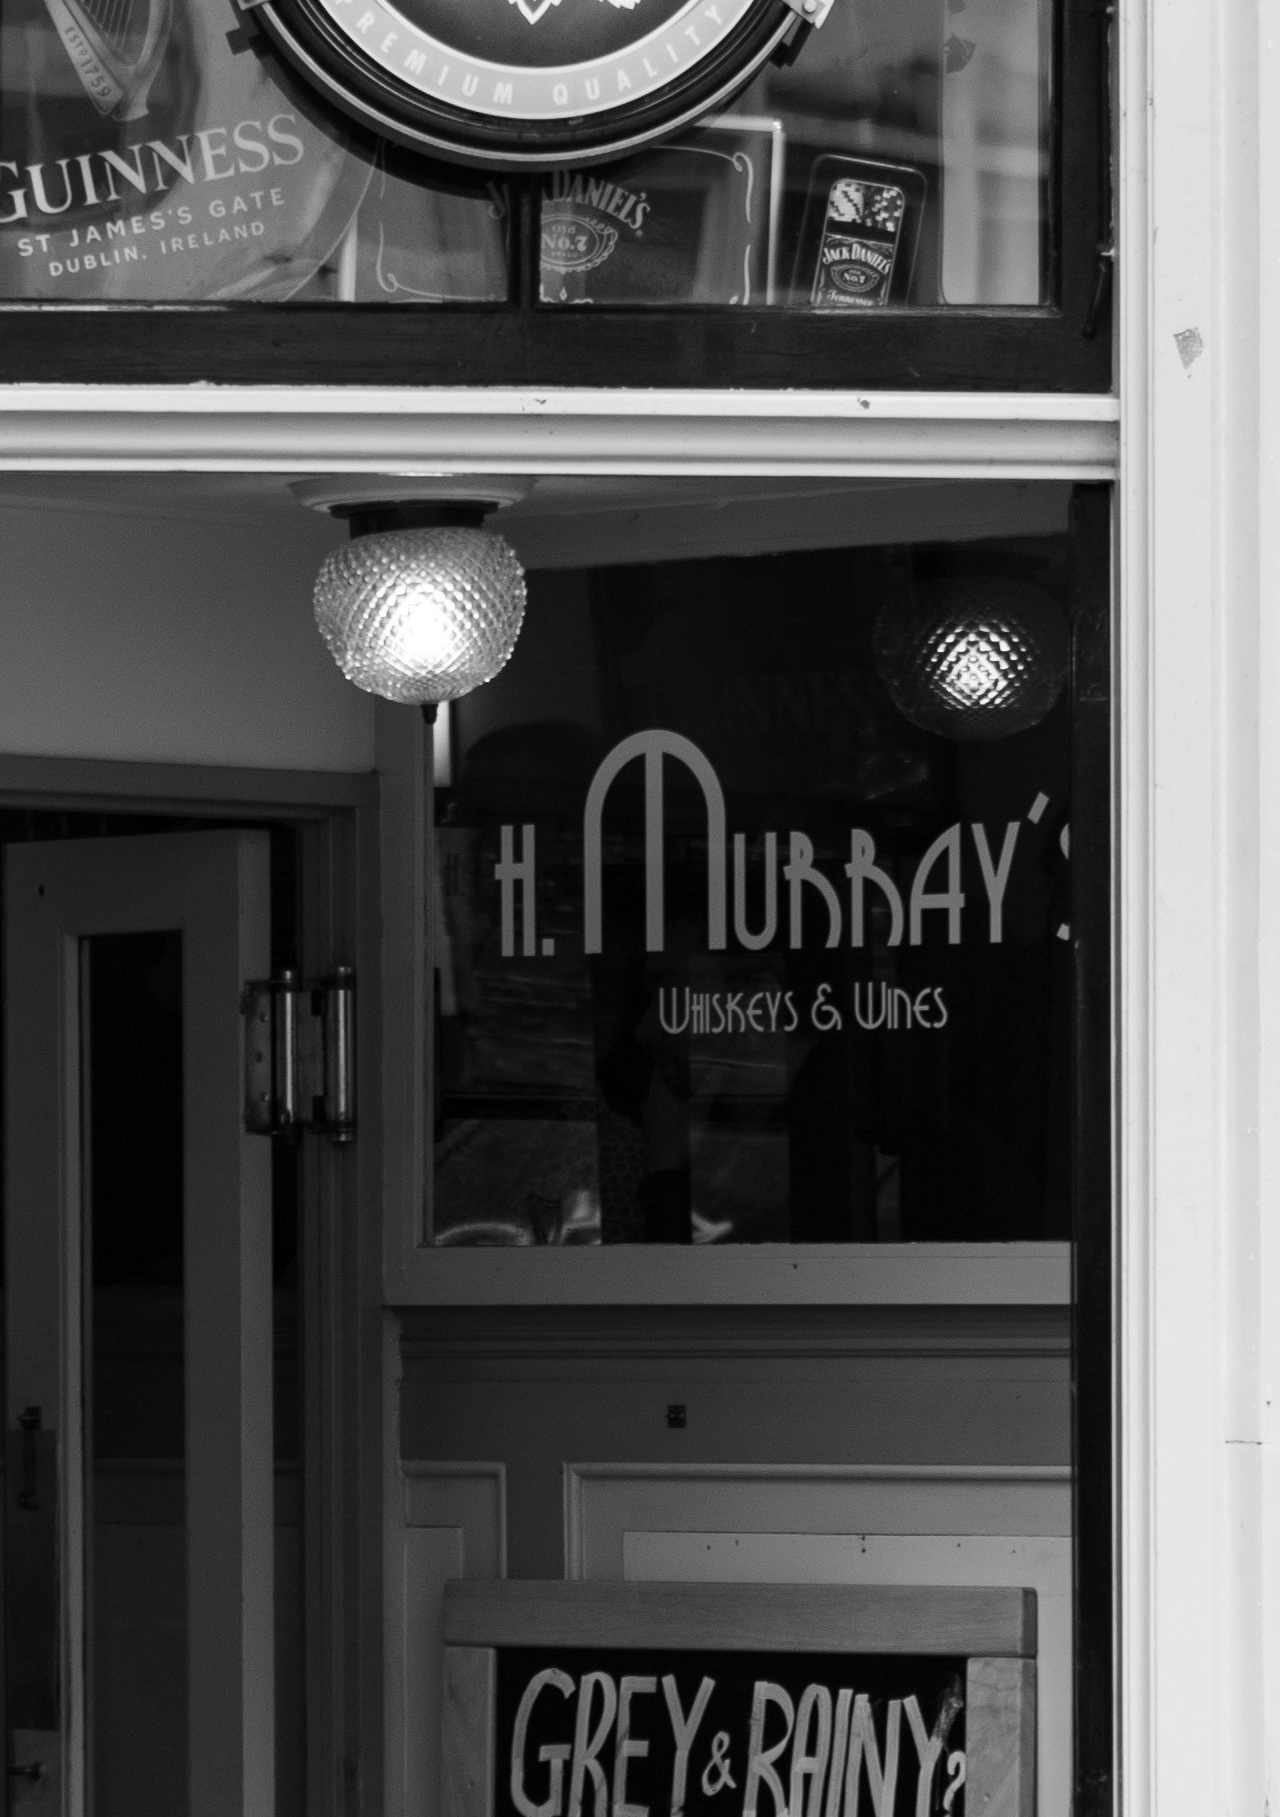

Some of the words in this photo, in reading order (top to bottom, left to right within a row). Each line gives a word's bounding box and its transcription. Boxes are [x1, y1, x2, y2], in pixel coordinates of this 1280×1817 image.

[552, 6, 725, 106] QUALITY
[17, 234, 51, 257] ST
[68, 207, 193, 247] JAMES'S
[209, 188, 285, 218] GATE
[159, 222, 266, 255] IRELAND
[493, 823, 556, 958] H.
[811, 982, 842, 1032] &
[702, 1731, 737, 1796] &
